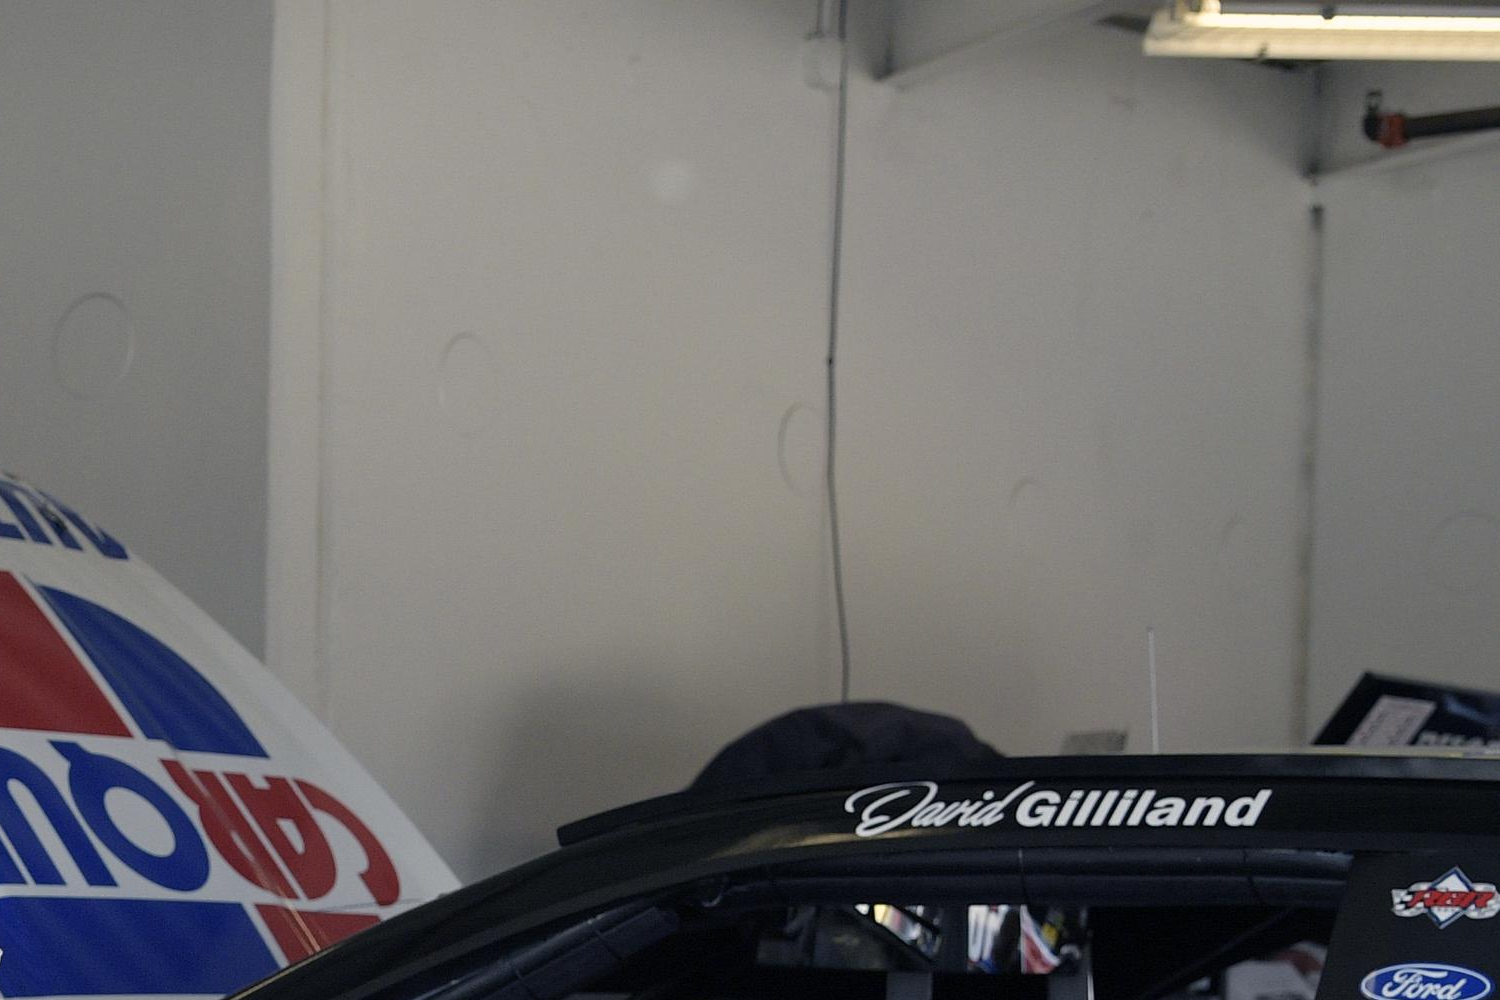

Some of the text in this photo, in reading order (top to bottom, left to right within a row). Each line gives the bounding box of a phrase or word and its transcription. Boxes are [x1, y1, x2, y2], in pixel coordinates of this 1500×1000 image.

[843, 780, 1273, 838] David Gilliland
[1381, 968, 1468, 1000] Ford
